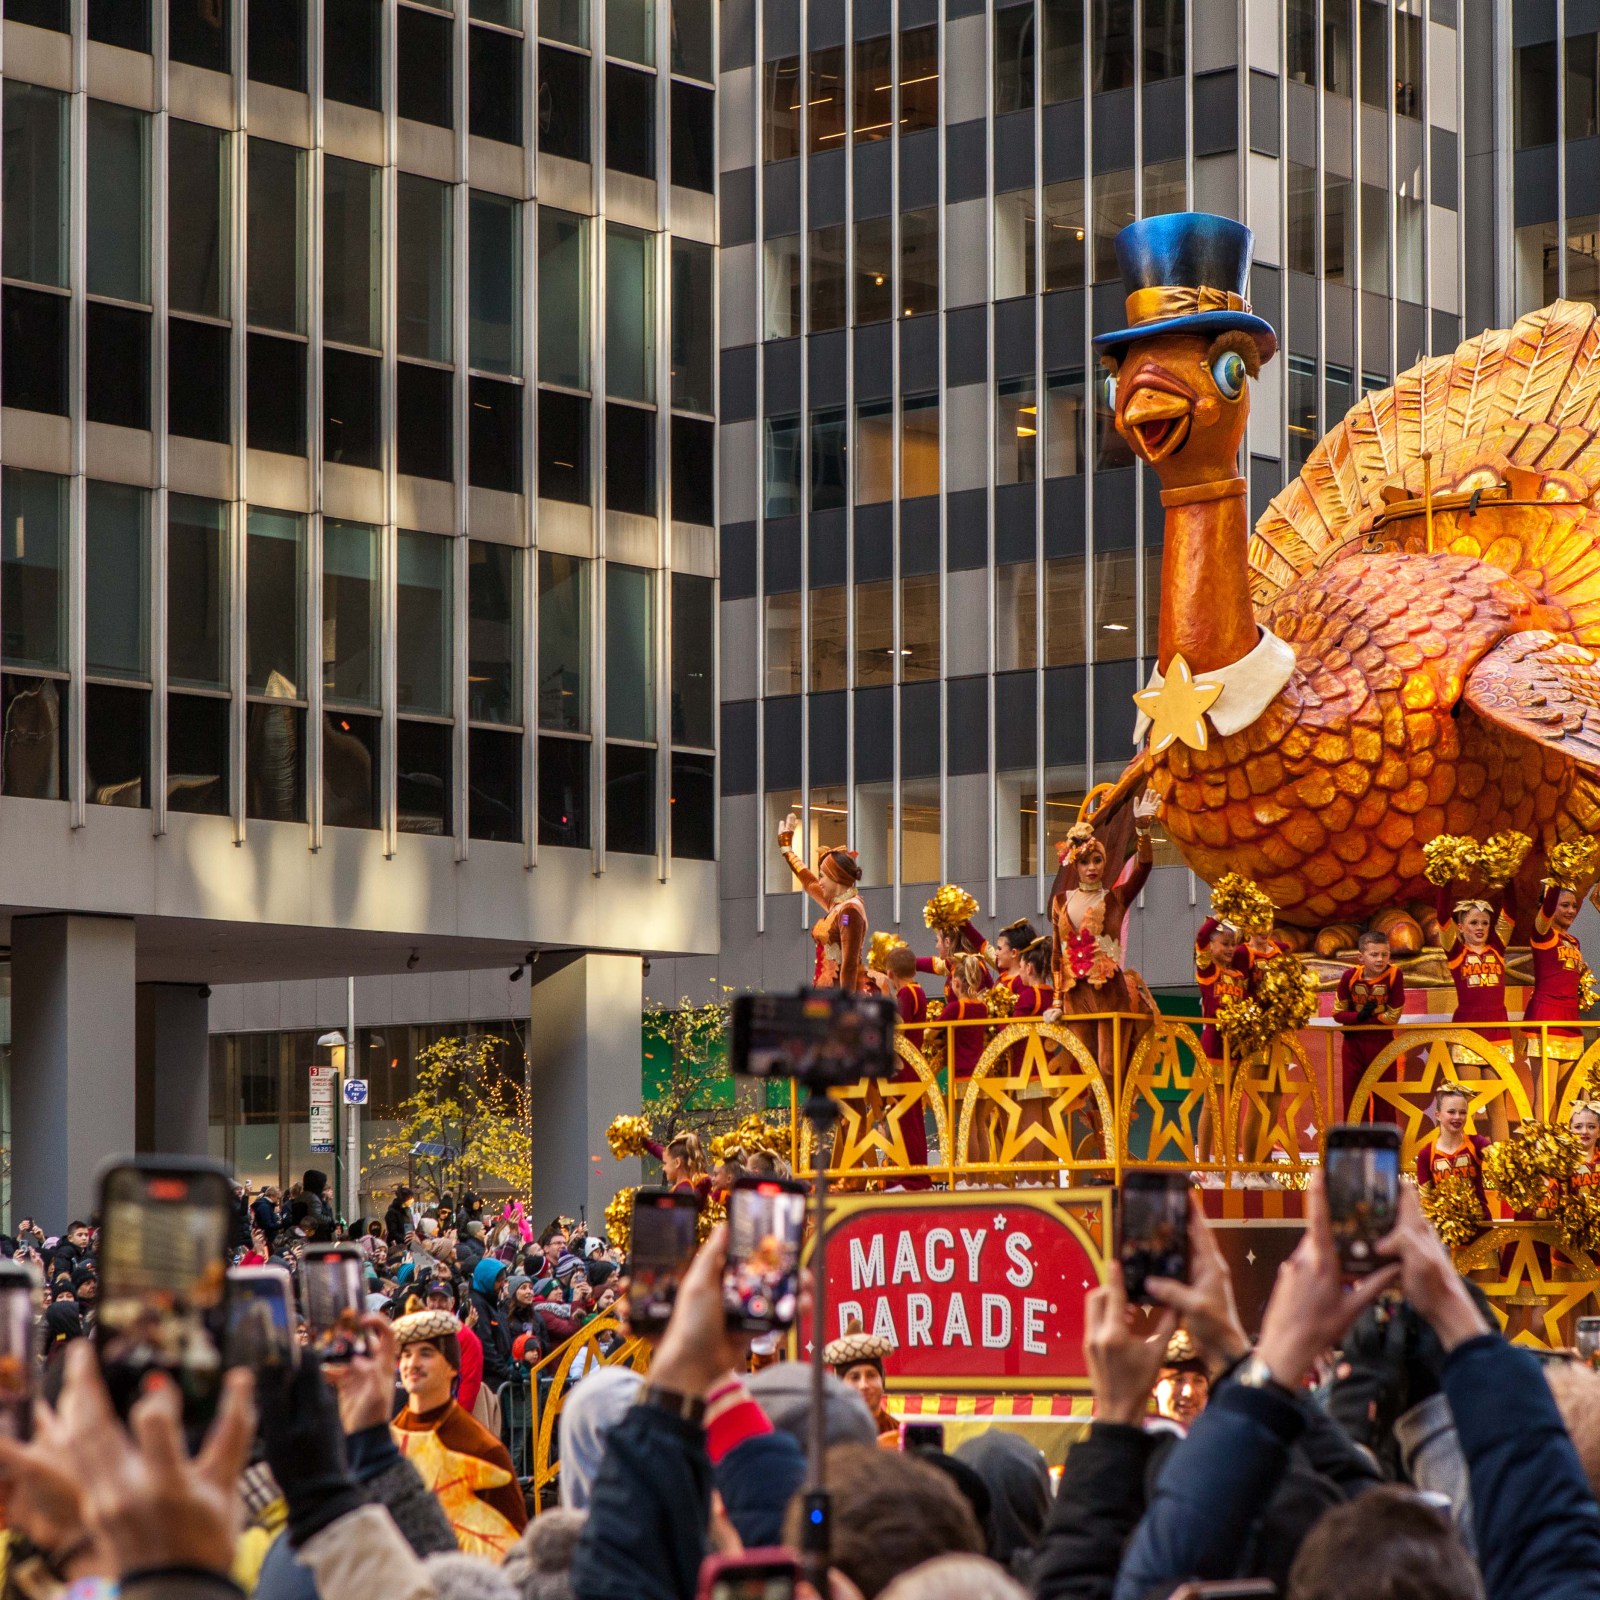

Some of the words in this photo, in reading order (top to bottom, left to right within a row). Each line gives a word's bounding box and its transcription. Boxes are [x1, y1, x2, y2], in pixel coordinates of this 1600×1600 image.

[1462, 963, 1502, 977] MACYS
[1571, 1173, 1600, 1187] MAC
[850, 1213, 1034, 1291] MACY'S
